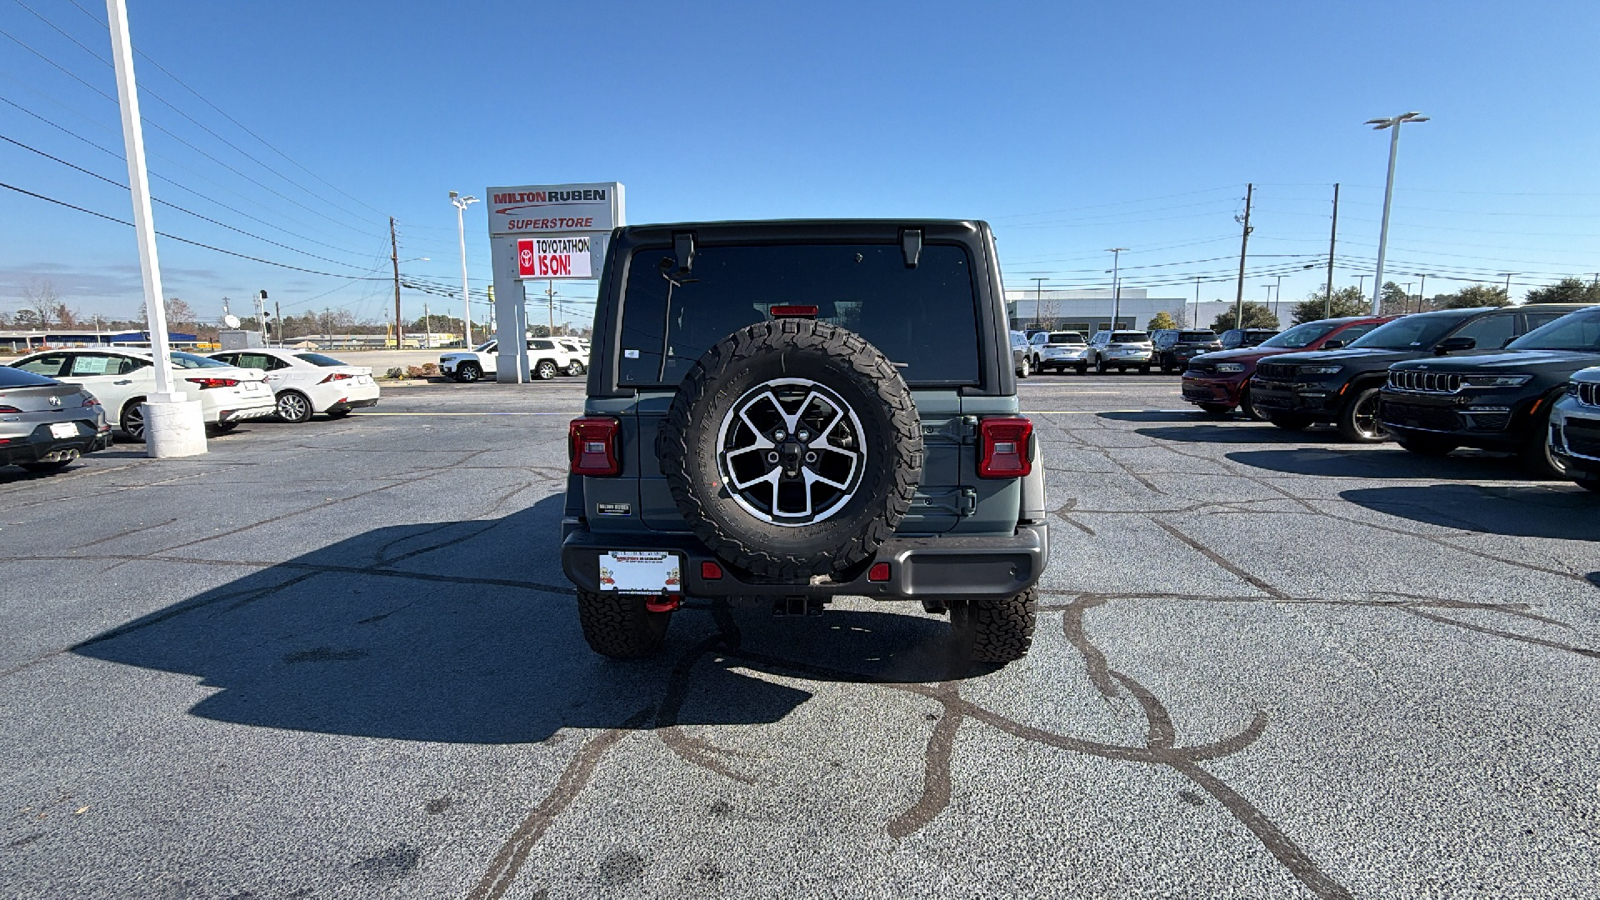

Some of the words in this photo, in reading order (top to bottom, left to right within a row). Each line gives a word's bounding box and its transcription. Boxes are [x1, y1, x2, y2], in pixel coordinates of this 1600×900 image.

[508, 217, 593, 230] SUPERSTORE
[536, 239, 590, 254] TOYOTATHON
[539, 255, 548, 275] IS
[550, 255, 571, 276] ON!
